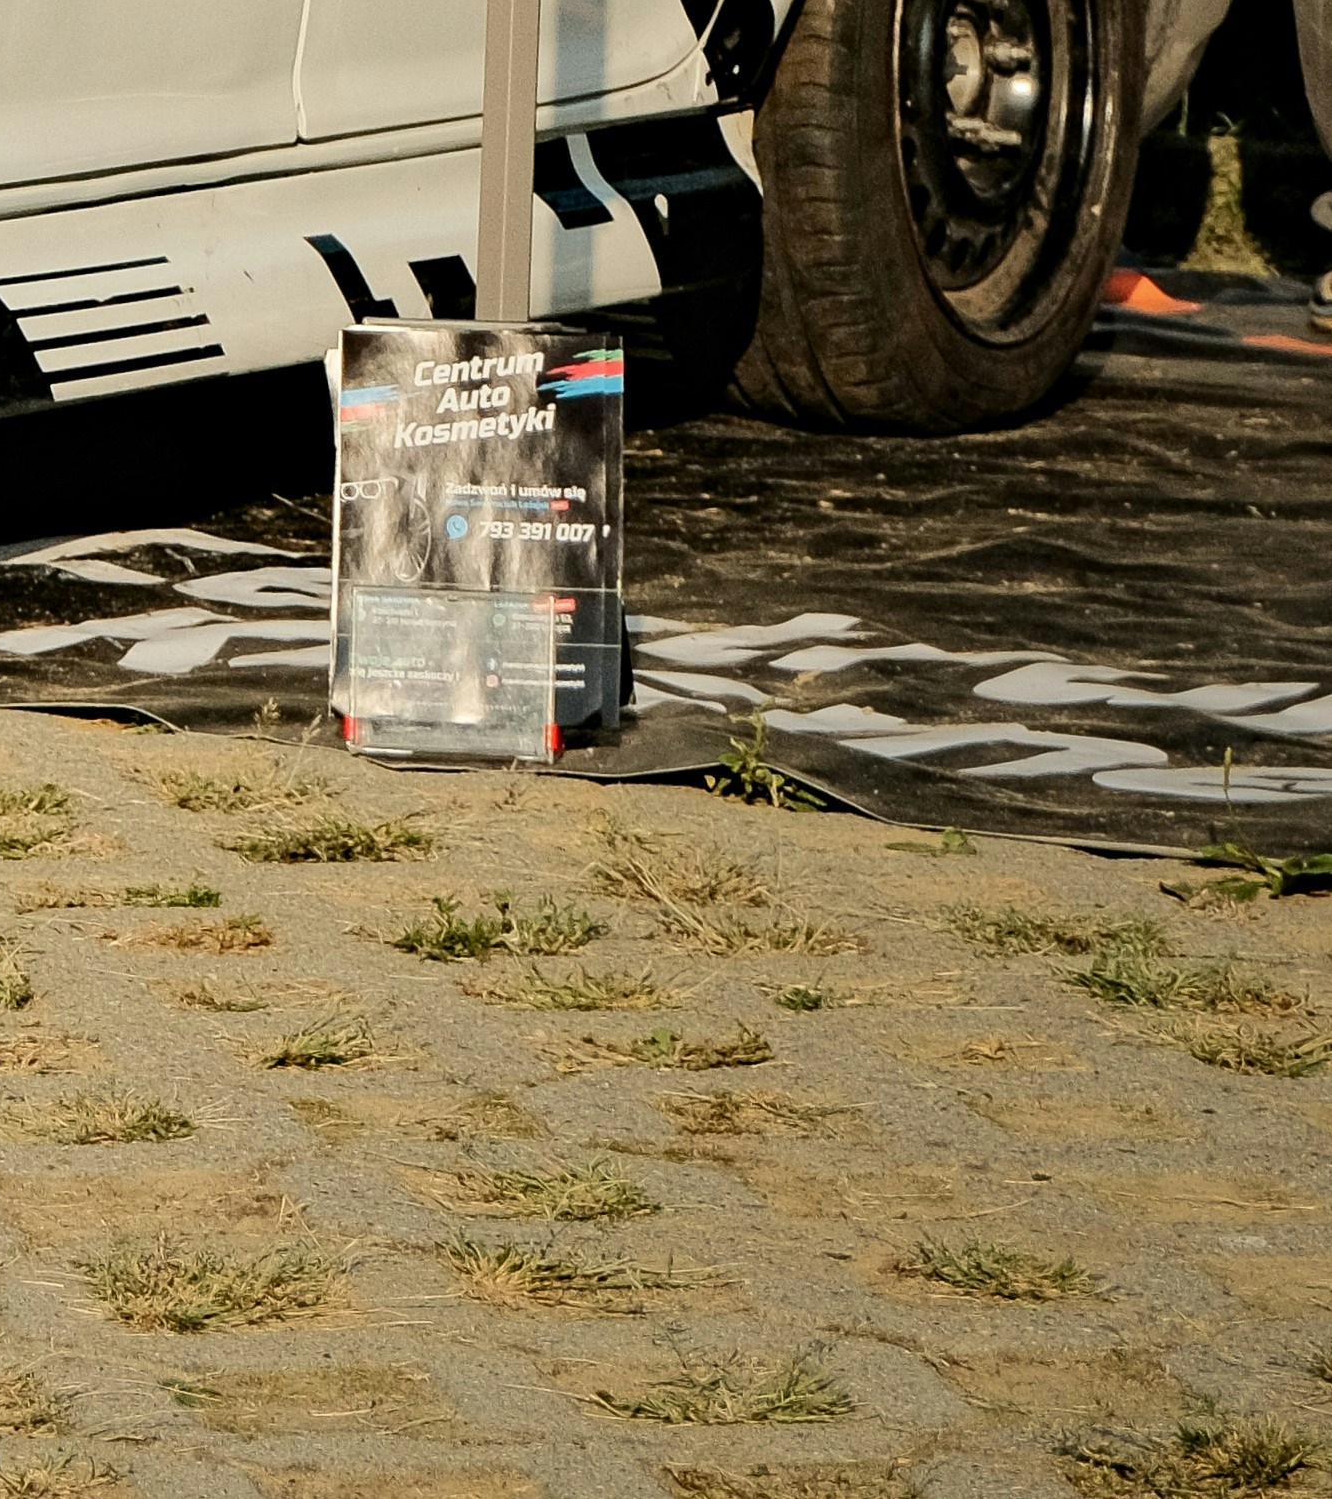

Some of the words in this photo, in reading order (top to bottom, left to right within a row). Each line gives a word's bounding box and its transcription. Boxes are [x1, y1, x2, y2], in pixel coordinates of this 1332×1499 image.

[413, 351, 545, 388] Centrum
[436, 384, 511, 414] Auto
[394, 403, 556, 449] Kosmetyki
[480, 521, 515, 540] 793
[518, 521, 552, 541] 391
[555, 522, 595, 542] 007
